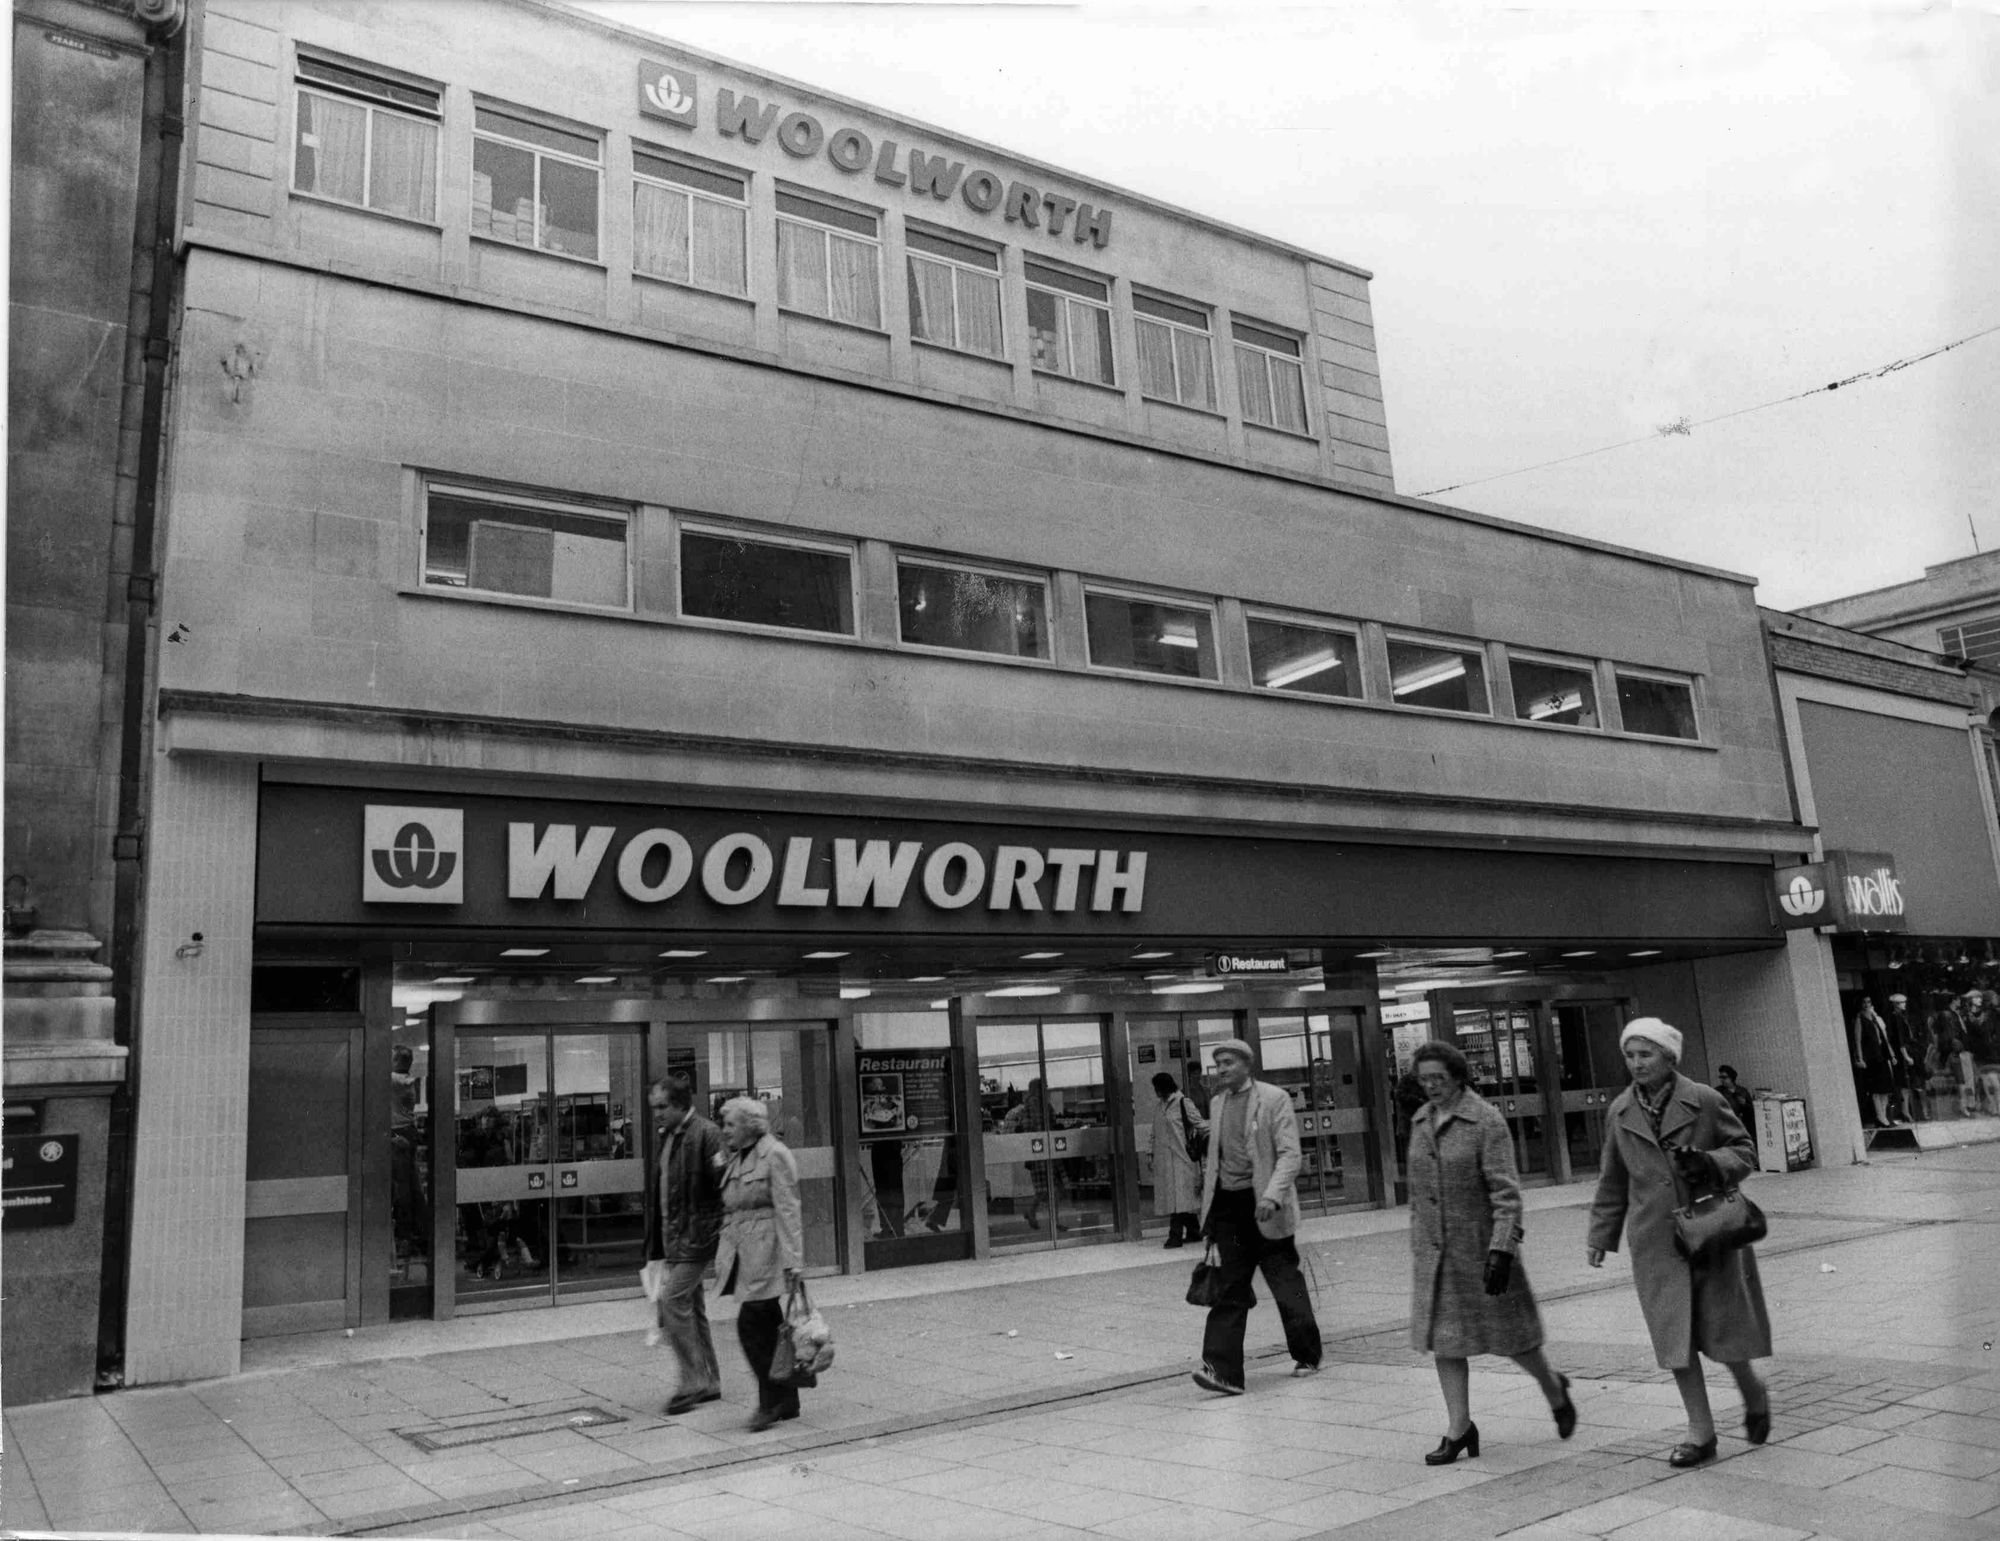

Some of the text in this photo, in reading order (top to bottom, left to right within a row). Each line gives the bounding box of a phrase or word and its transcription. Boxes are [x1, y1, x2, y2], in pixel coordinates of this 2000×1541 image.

[716, 87, 1112, 248] WOOLWORTH
[507, 822, 1147, 911] WOOLWORTH
[1232, 957, 1286, 970] Restaurant
[860, 1056, 946, 1071] Restaurant
